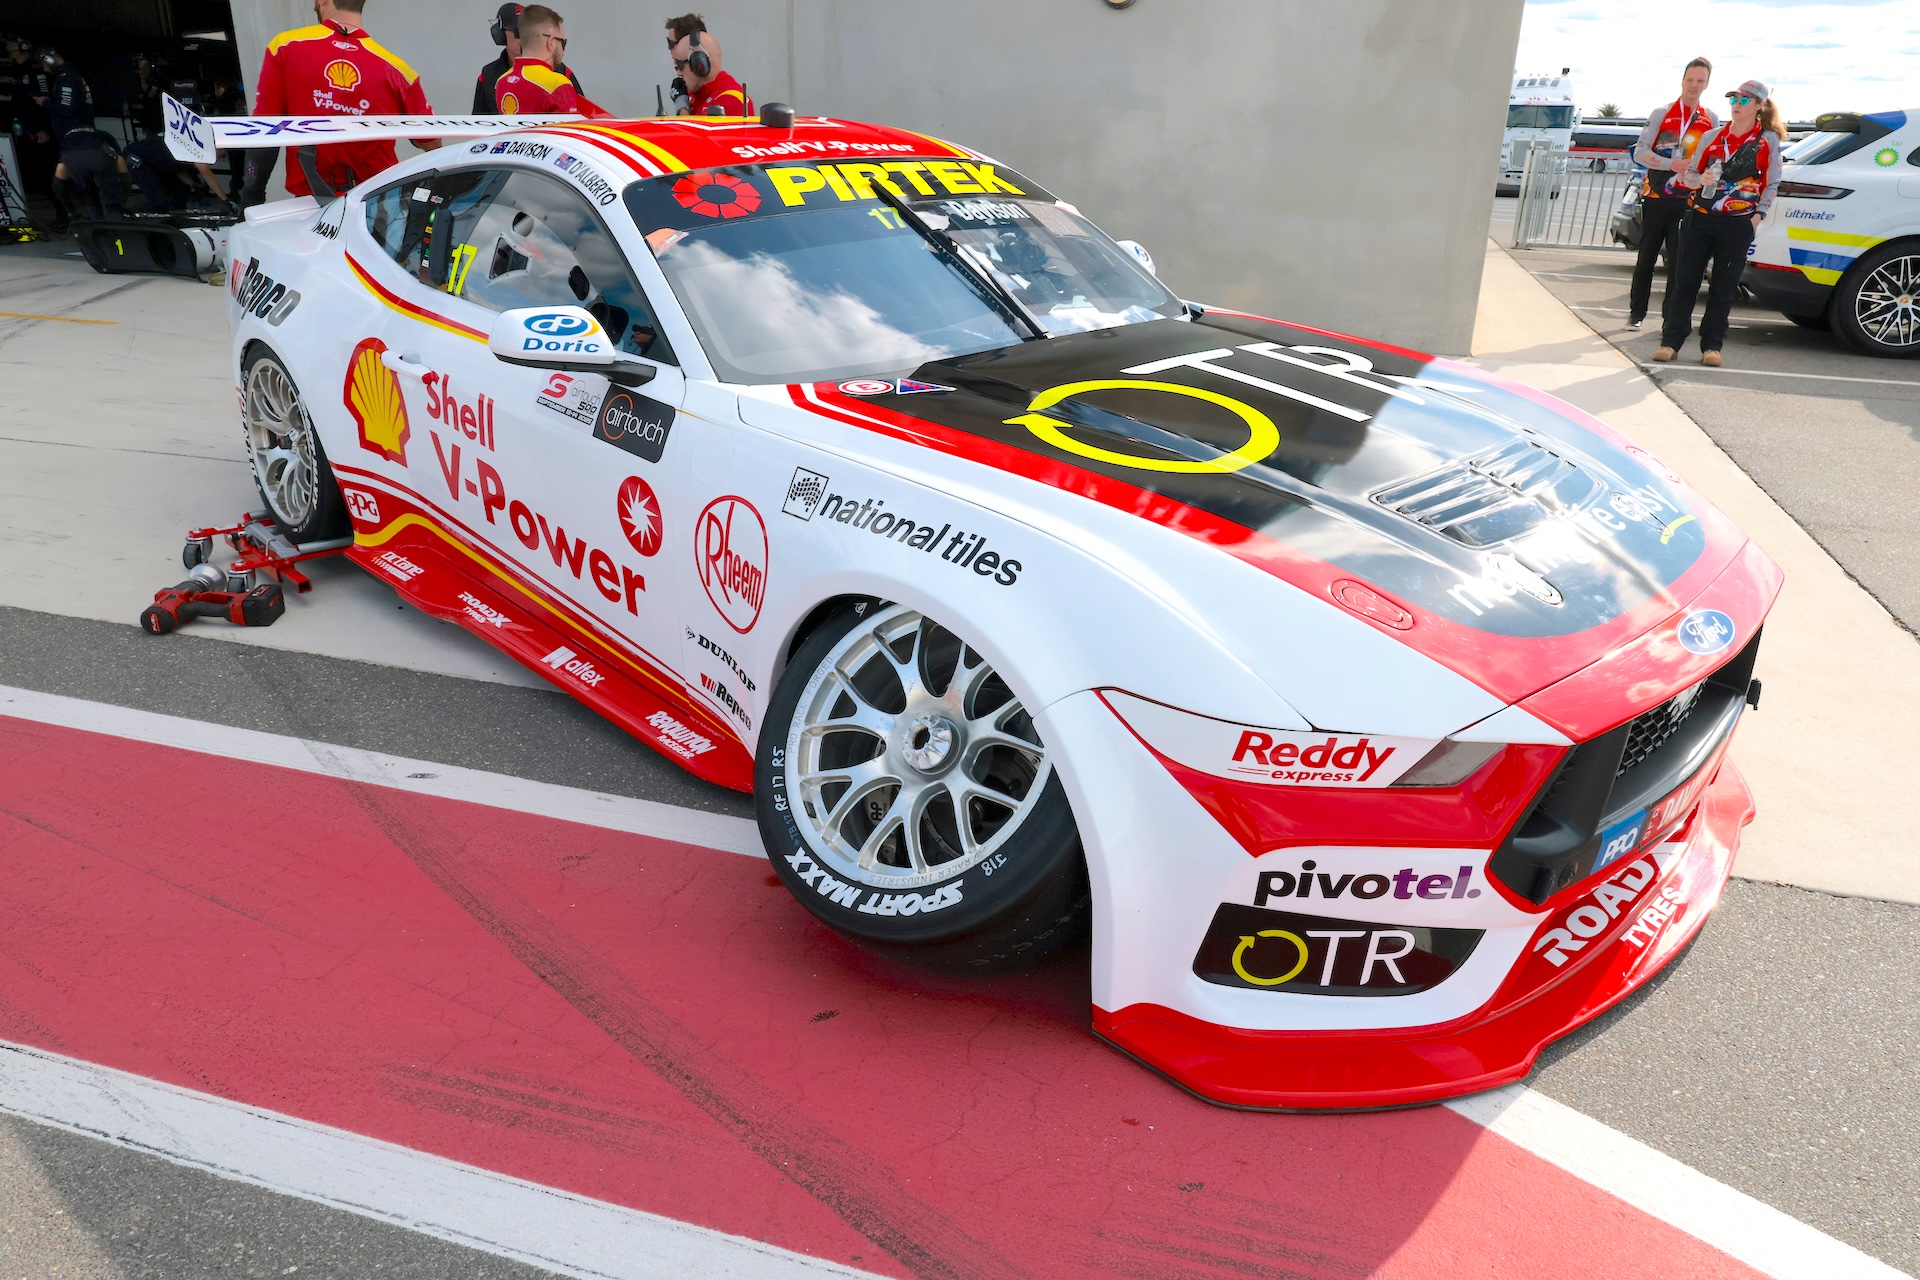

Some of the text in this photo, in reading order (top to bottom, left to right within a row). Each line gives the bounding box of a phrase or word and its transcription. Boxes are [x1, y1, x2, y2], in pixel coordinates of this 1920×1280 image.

[312, 89, 333, 100] Shell
[312, 97, 366, 116] V-Power
[171, 131, 204, 160] TECHNOLOGY
[506, 141, 554, 161] DAVISON
[731, 139, 915, 159] Shell V-Power
[1891, 140, 1903, 148] bp
[568, 161, 617, 207] D'ALBERTO
[765, 160, 1027, 208] PIRTEK
[313, 221, 338, 240] MAN
[867, 207, 907, 230] 17
[1785, 209, 1836, 221] ultimate
[447, 243, 479, 295] 17
[236, 256, 301, 327] Repco
[522, 337, 600, 354] Doric
[571, 386, 601, 406] airtouch
[577, 401, 598, 415] 500
[422, 371, 495, 453] Shell
[605, 407, 665, 444] airtouch
[347, 491, 378, 518] PPG
[430, 430, 646, 617] V-Power
[819, 491, 1022, 586] national tiles
[380, 551, 425, 577] octane
[704, 501, 764, 612] Rheem
[458, 590, 513, 629] ROADX
[463, 606, 486, 624] TYRES
[1685, 615, 1729, 649] Ford
[698, 634, 756, 692] DUNLOP
[715, 681, 752, 731] Repco
[787, 656, 834, 755] PRO RACE FORGED
[645, 710, 717, 755] REVOLUTION
[657, 735, 695, 760] RACEGEAR
[1231, 729, 1397, 782] Reddy
[1270, 769, 1355, 784] express
[774, 797, 789, 813] RF
[783, 846, 964, 917] SPORT MAXX
[867, 857, 972, 886] RACER INDUSTRIES
[1253, 859, 1482, 907] pivotel.
[1619, 886, 1681, 949] TYRES
